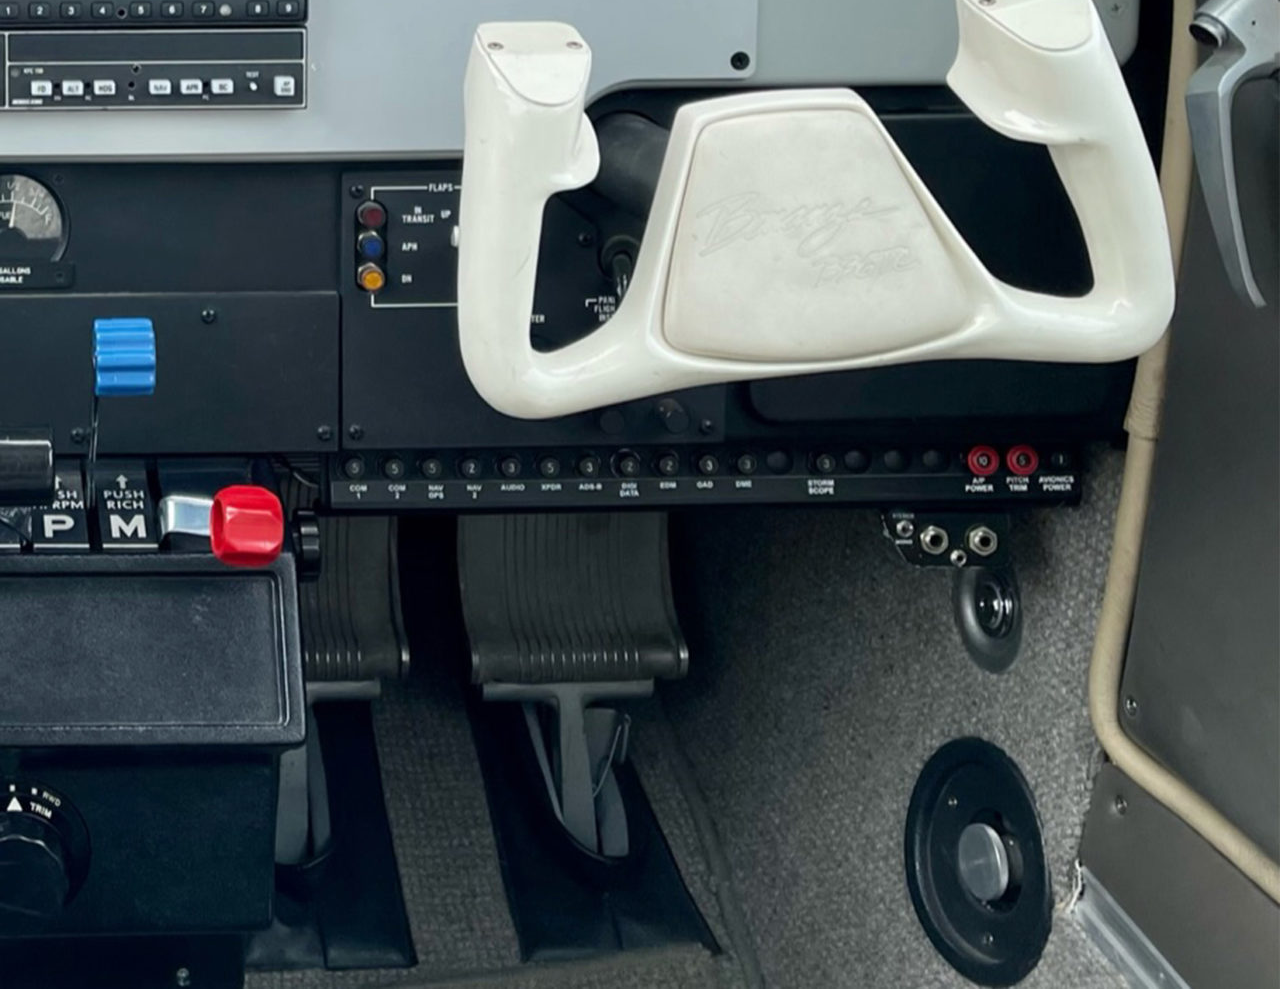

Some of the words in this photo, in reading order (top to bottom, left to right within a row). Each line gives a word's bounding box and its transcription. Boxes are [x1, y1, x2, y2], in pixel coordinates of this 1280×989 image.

[6, 7, 11, 15] 1
[36, 7, 44, 15] 2
[68, 7, 74, 15] 3
[99, 7, 106, 15] 4
[138, 5, 144, 13] 5
[169, 5, 176, 13] 6
[200, 5, 206, 13] 7
[255, 4, 262, 13] 8
[286, 3, 292, 13] 9
[428, 183, 453, 192] FLAPS
[440, 209, 451, 219] UP
[402, 215, 434, 223] TRANSIT
[402, 275, 412, 283] DN
[808, 479, 835, 487] STORM
[1040, 476, 1074, 484] AVIONICS
[808, 487, 835, 495] SCOPE
[1043, 483, 1072, 492] POWER
[104, 490, 144, 499] PUSH
[52, 501, 84, 509] RPM
[106, 500, 144, 509] RICH
[43, 515, 75, 538] P
[110, 515, 147, 538] M
[42, 791, 62, 807] RWD
[30, 801, 52, 819] TRIM
